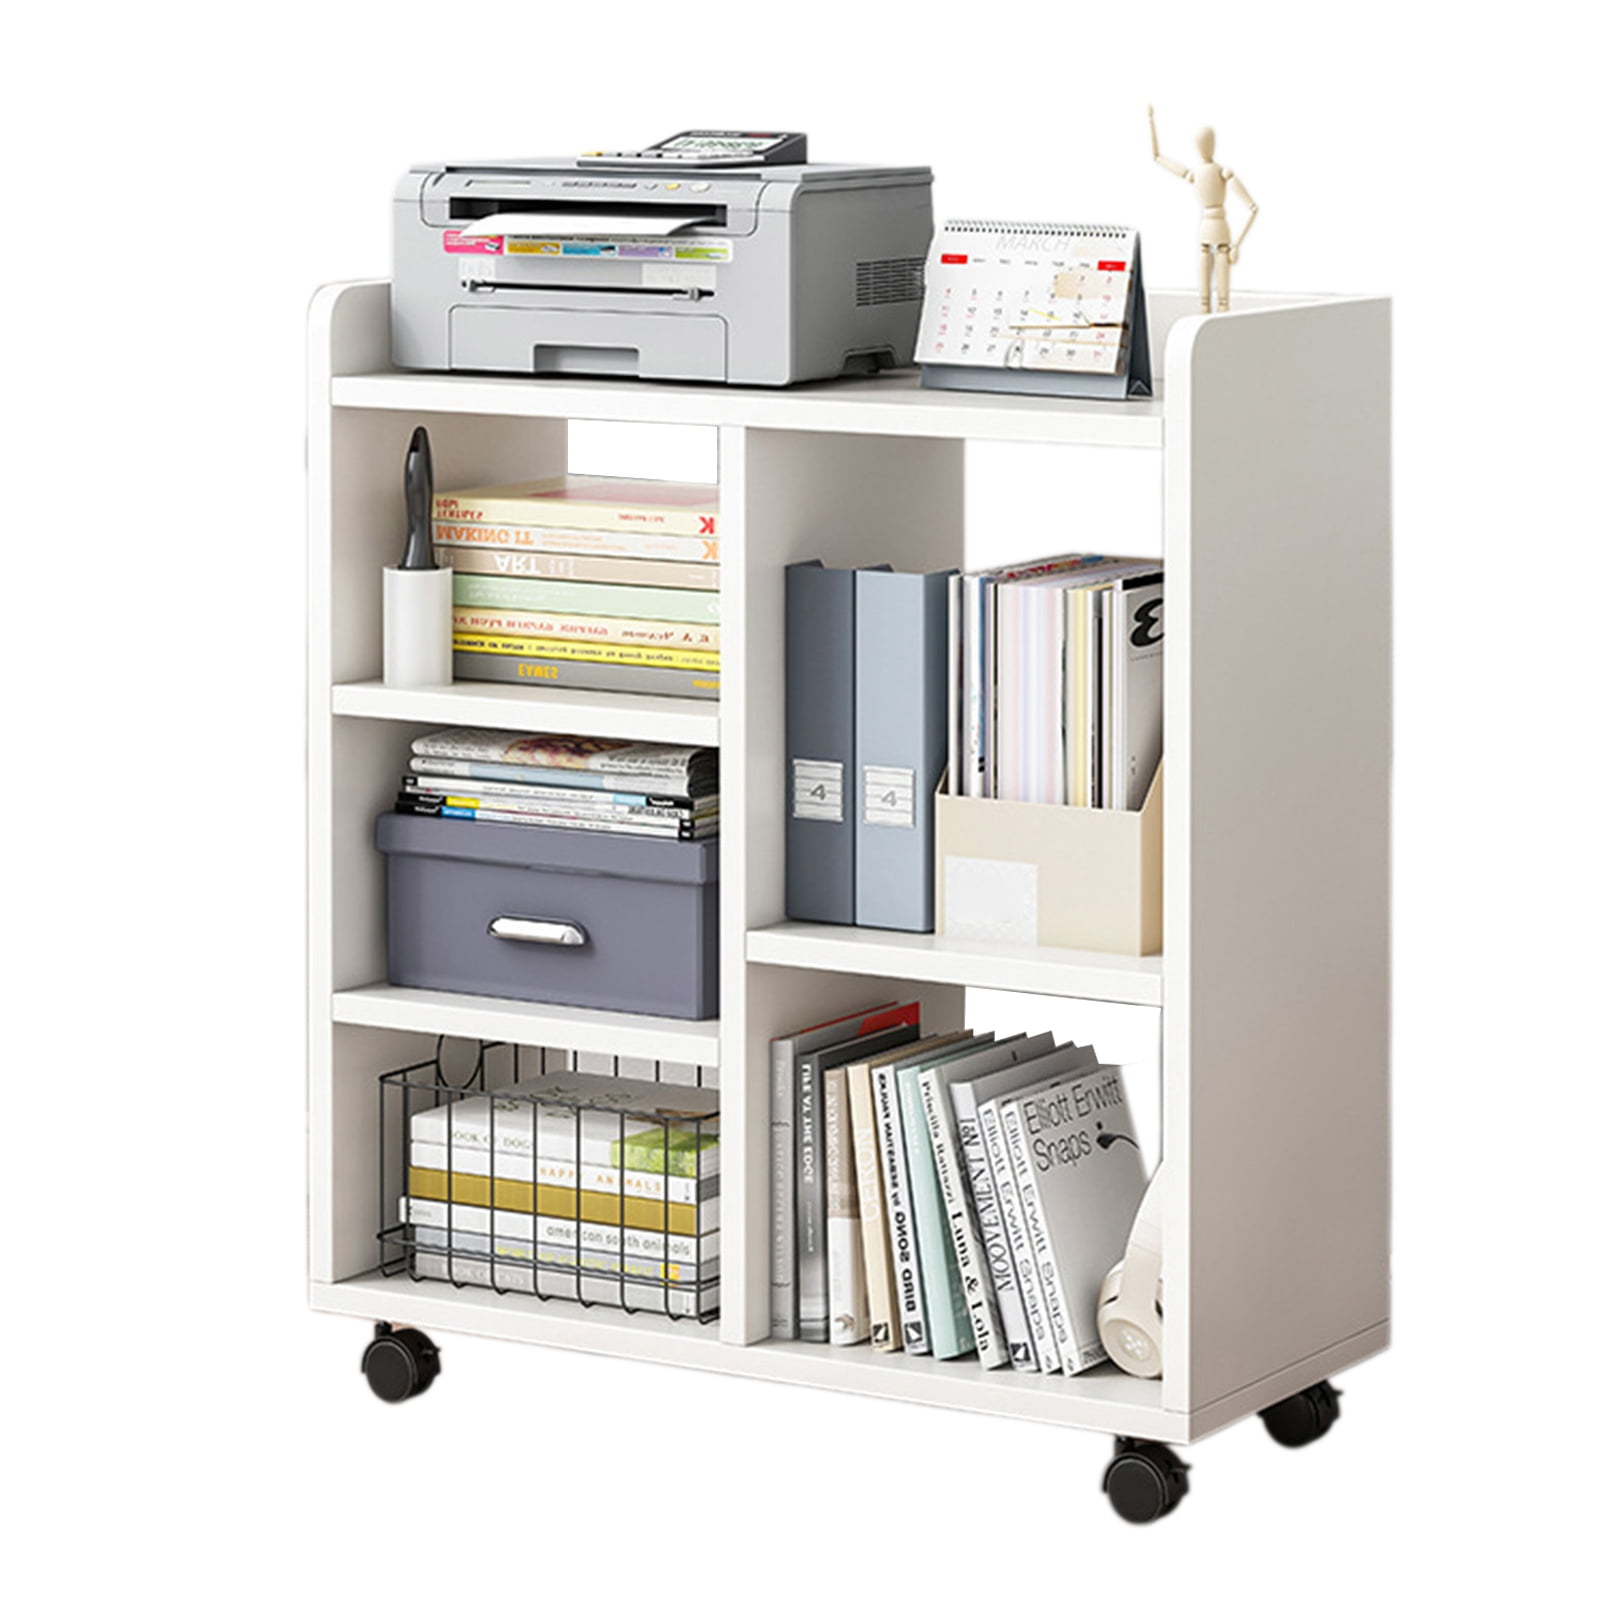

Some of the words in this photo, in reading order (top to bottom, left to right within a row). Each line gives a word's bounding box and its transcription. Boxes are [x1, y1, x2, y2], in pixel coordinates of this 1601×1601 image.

[995, 234, 1071, 252] MARCH
[699, 516, 715, 534] K
[1023, 1093, 1074, 1135] Elliott
[1071, 1076, 1123, 1118] Erwitt
[1032, 1130, 1093, 1172] Snaps
[539, 1166, 584, 1180] HAPP
[595, 1173, 662, 1192] ANMALS
[605, 1234, 640, 1248] soth
[642, 1238, 690, 1256] anials
[951, 1211, 971, 1268] Luna
[983, 1108, 1006, 1175] Elliott
[1000, 1181, 1024, 1251] Erwitt
[1019, 1258, 1045, 1341] Snaps
[1004, 1111, 1028, 1176] Elliott
[1022, 1183, 1047, 1253] Erwitt
[1041, 1261, 1068, 1344] Snaps
[964, 1275, 979, 1295] &
[971, 1301, 990, 1352] Lola
